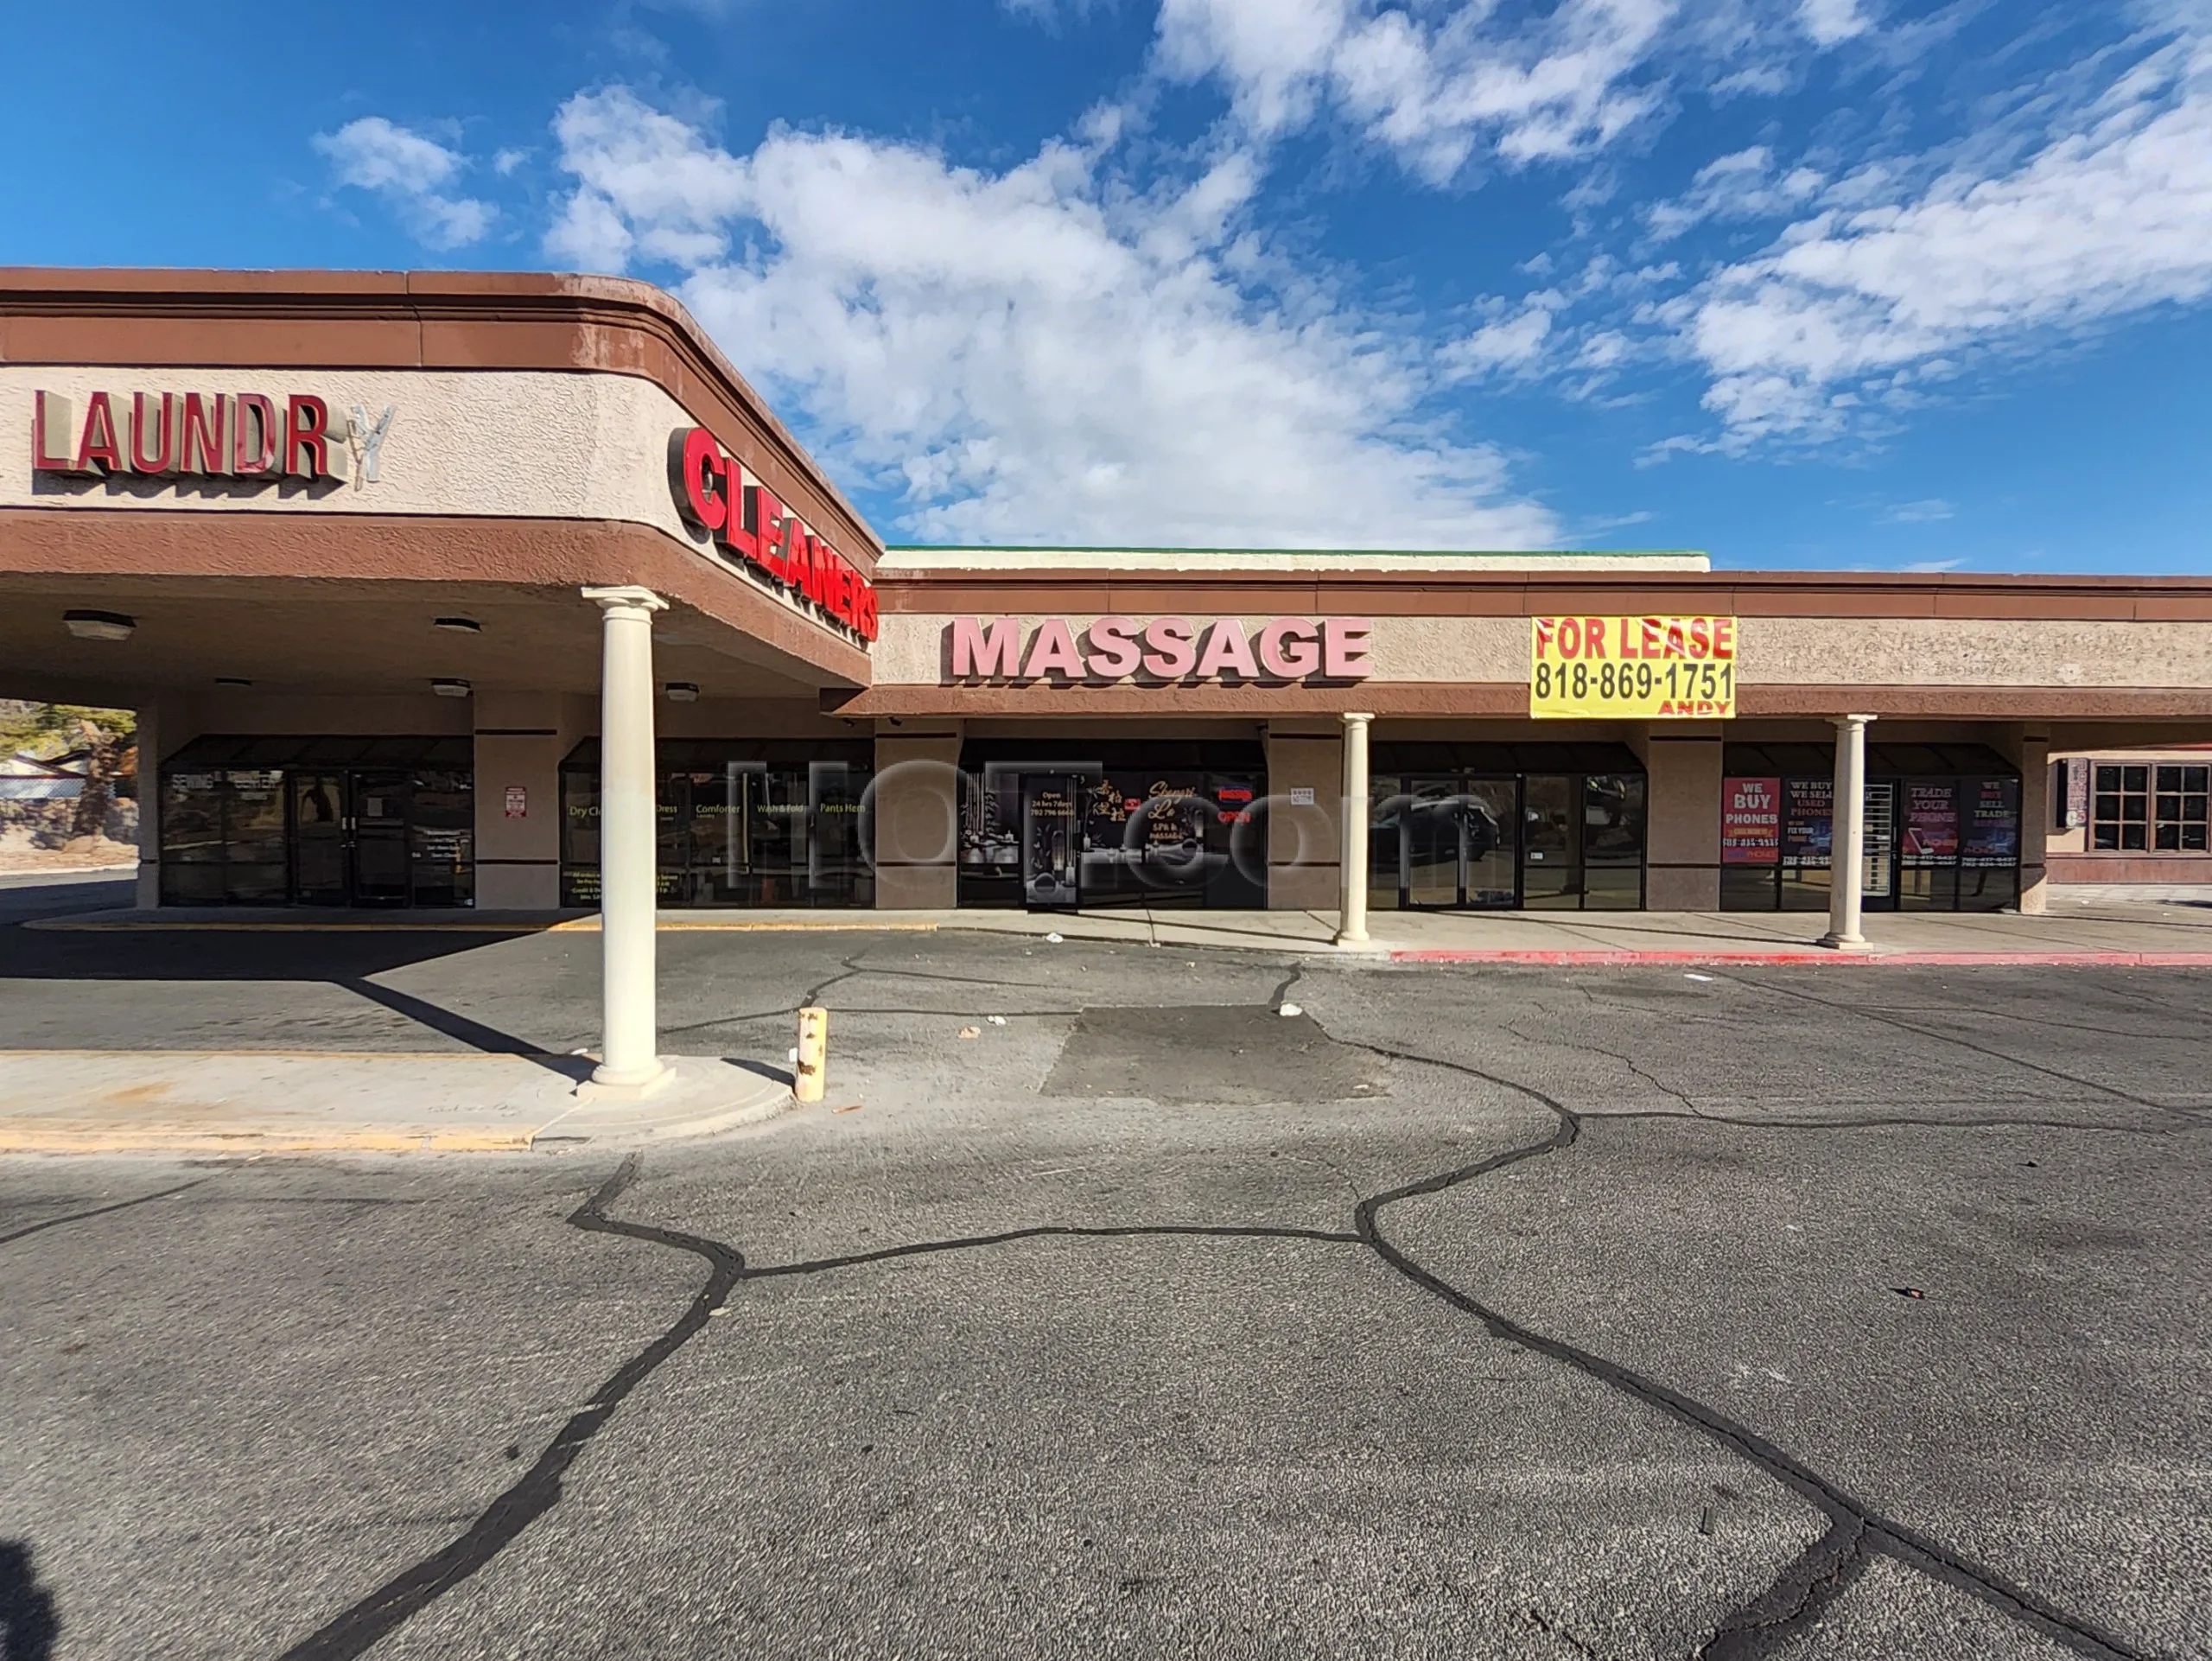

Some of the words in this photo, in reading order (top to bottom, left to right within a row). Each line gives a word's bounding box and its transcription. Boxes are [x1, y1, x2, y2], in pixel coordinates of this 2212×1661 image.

[33, 390, 396, 488] LAUNDRY
[672, 427, 879, 642] CLEANERS
[1535, 618, 1607, 659] FOR
[1619, 617, 1733, 659] LEASE
[952, 616, 1374, 678] MASSAGE
[1535, 662, 1732, 700] 818-869-1751
[1658, 700, 1732, 716] ANDY
[1742, 783, 1763, 793] WE
[1789, 781, 1808, 790] WE
[1809, 781, 1832, 790] BUY
[1042, 792, 1061, 800] Open
[1789, 790, 1808, 799] WE
[1808, 790, 1833, 799] SELL
[1910, 787, 1952, 798] TRADE
[1734, 793, 1771, 809] BUY
[1913, 799, 1948, 810] YOUR
[569, 805, 588, 818] Dry
[696, 804, 741, 814] Comforter
[757, 805, 778, 813] Wash
[786, 804, 804, 813] Fold
[820, 803, 843, 813] Pants
[844, 803, 865, 813] Hem
[1147, 799, 1176, 820] La
[1217, 811, 1252, 824] OPEN
[1726, 814, 1778, 824] PHONES
[1909, 812, 1955, 823] PHONE
